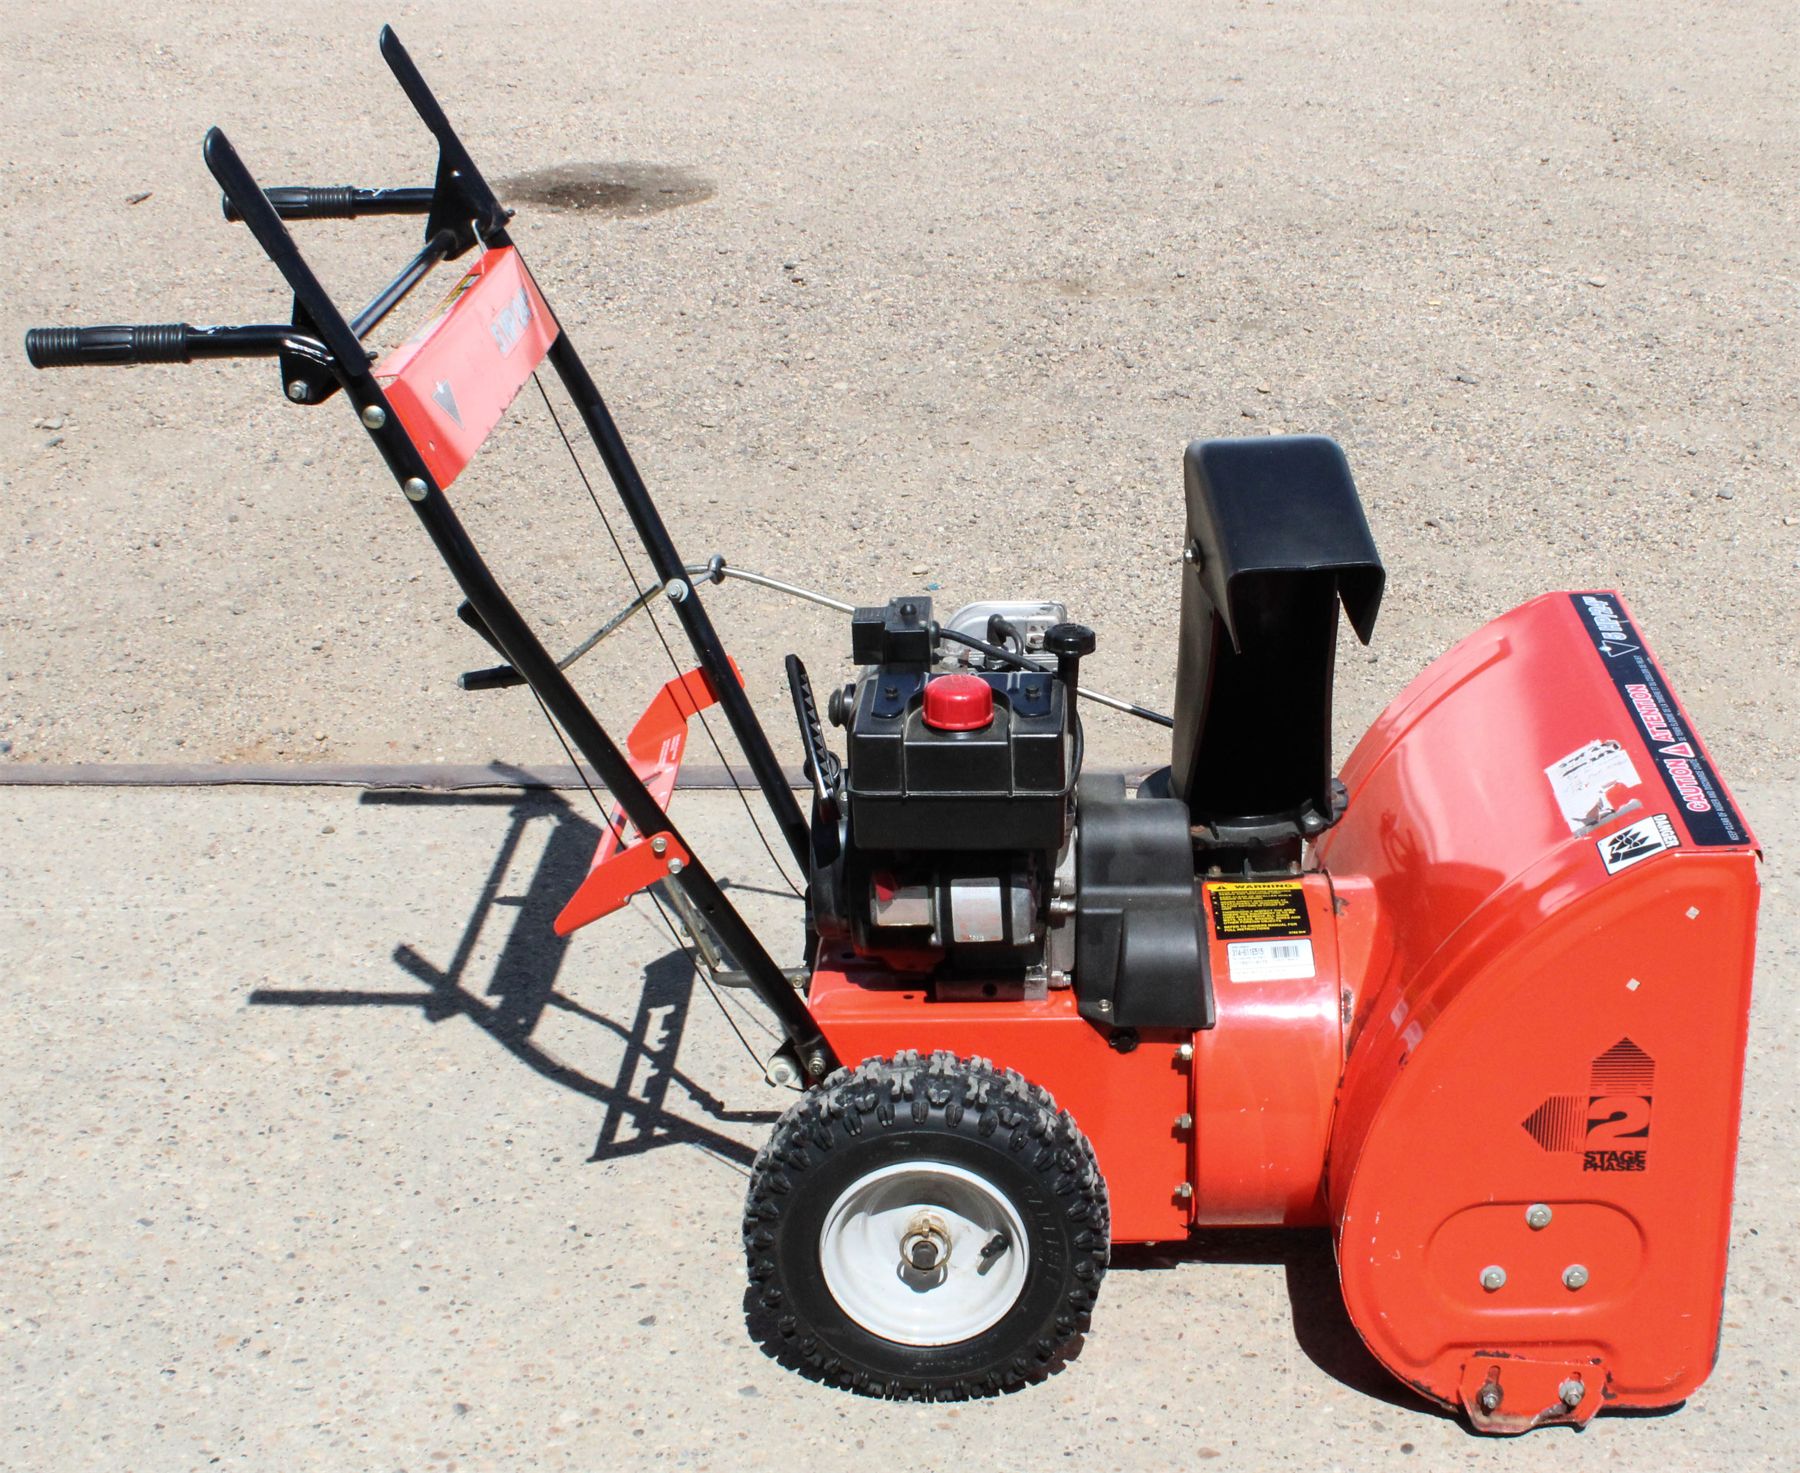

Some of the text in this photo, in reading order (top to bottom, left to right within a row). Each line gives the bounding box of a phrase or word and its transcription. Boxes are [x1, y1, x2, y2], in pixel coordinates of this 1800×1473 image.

[1600, 632, 1629, 640] 5
[1623, 684, 1713, 811] CAUTION ATTENTION
[1653, 813, 1679, 848] DANGER
[1585, 1096, 1652, 1151] 2
[1583, 1161, 1646, 1172] PHASES
[1584, 1151, 1647, 1163] STAGE
